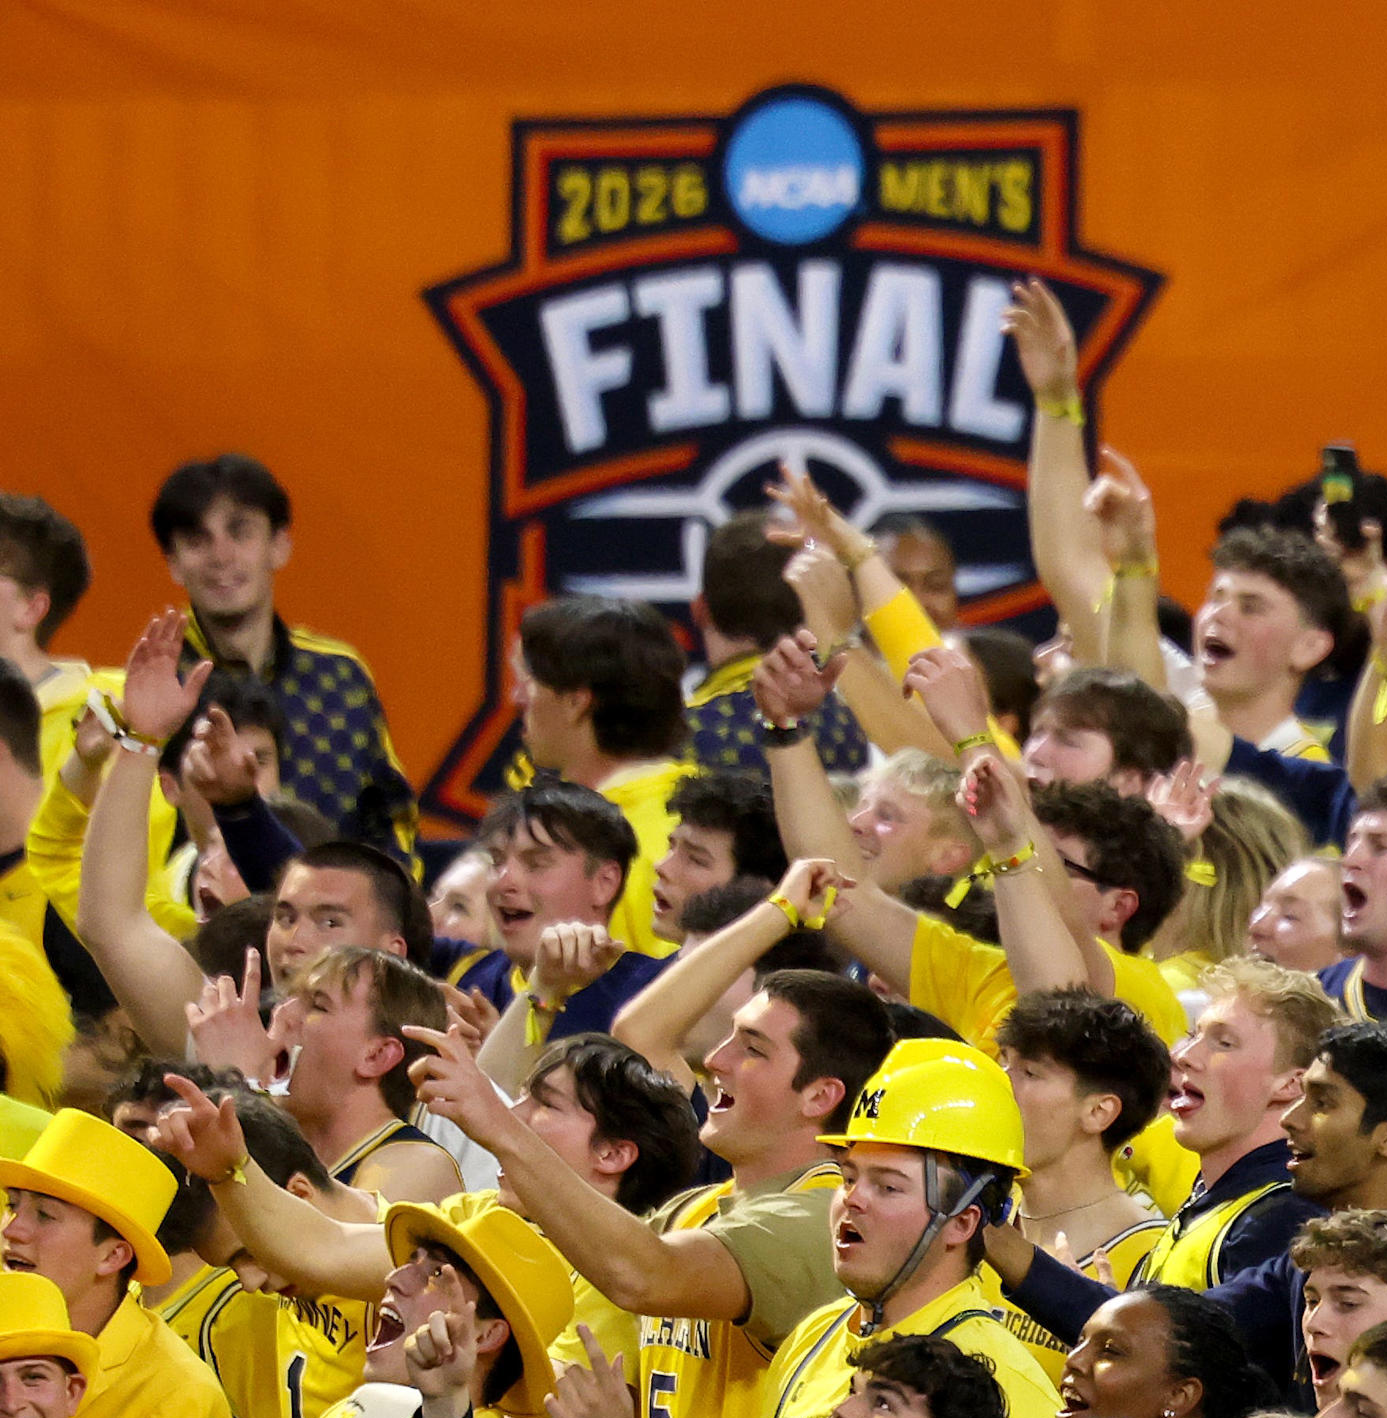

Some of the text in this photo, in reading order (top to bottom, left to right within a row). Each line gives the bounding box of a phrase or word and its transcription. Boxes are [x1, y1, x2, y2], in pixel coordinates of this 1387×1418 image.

[556, 164, 709, 245] 2026
[740, 166, 862, 213] NCAA
[878, 157, 1034, 235] MEN'S
[538, 256, 1026, 455] FINAL
